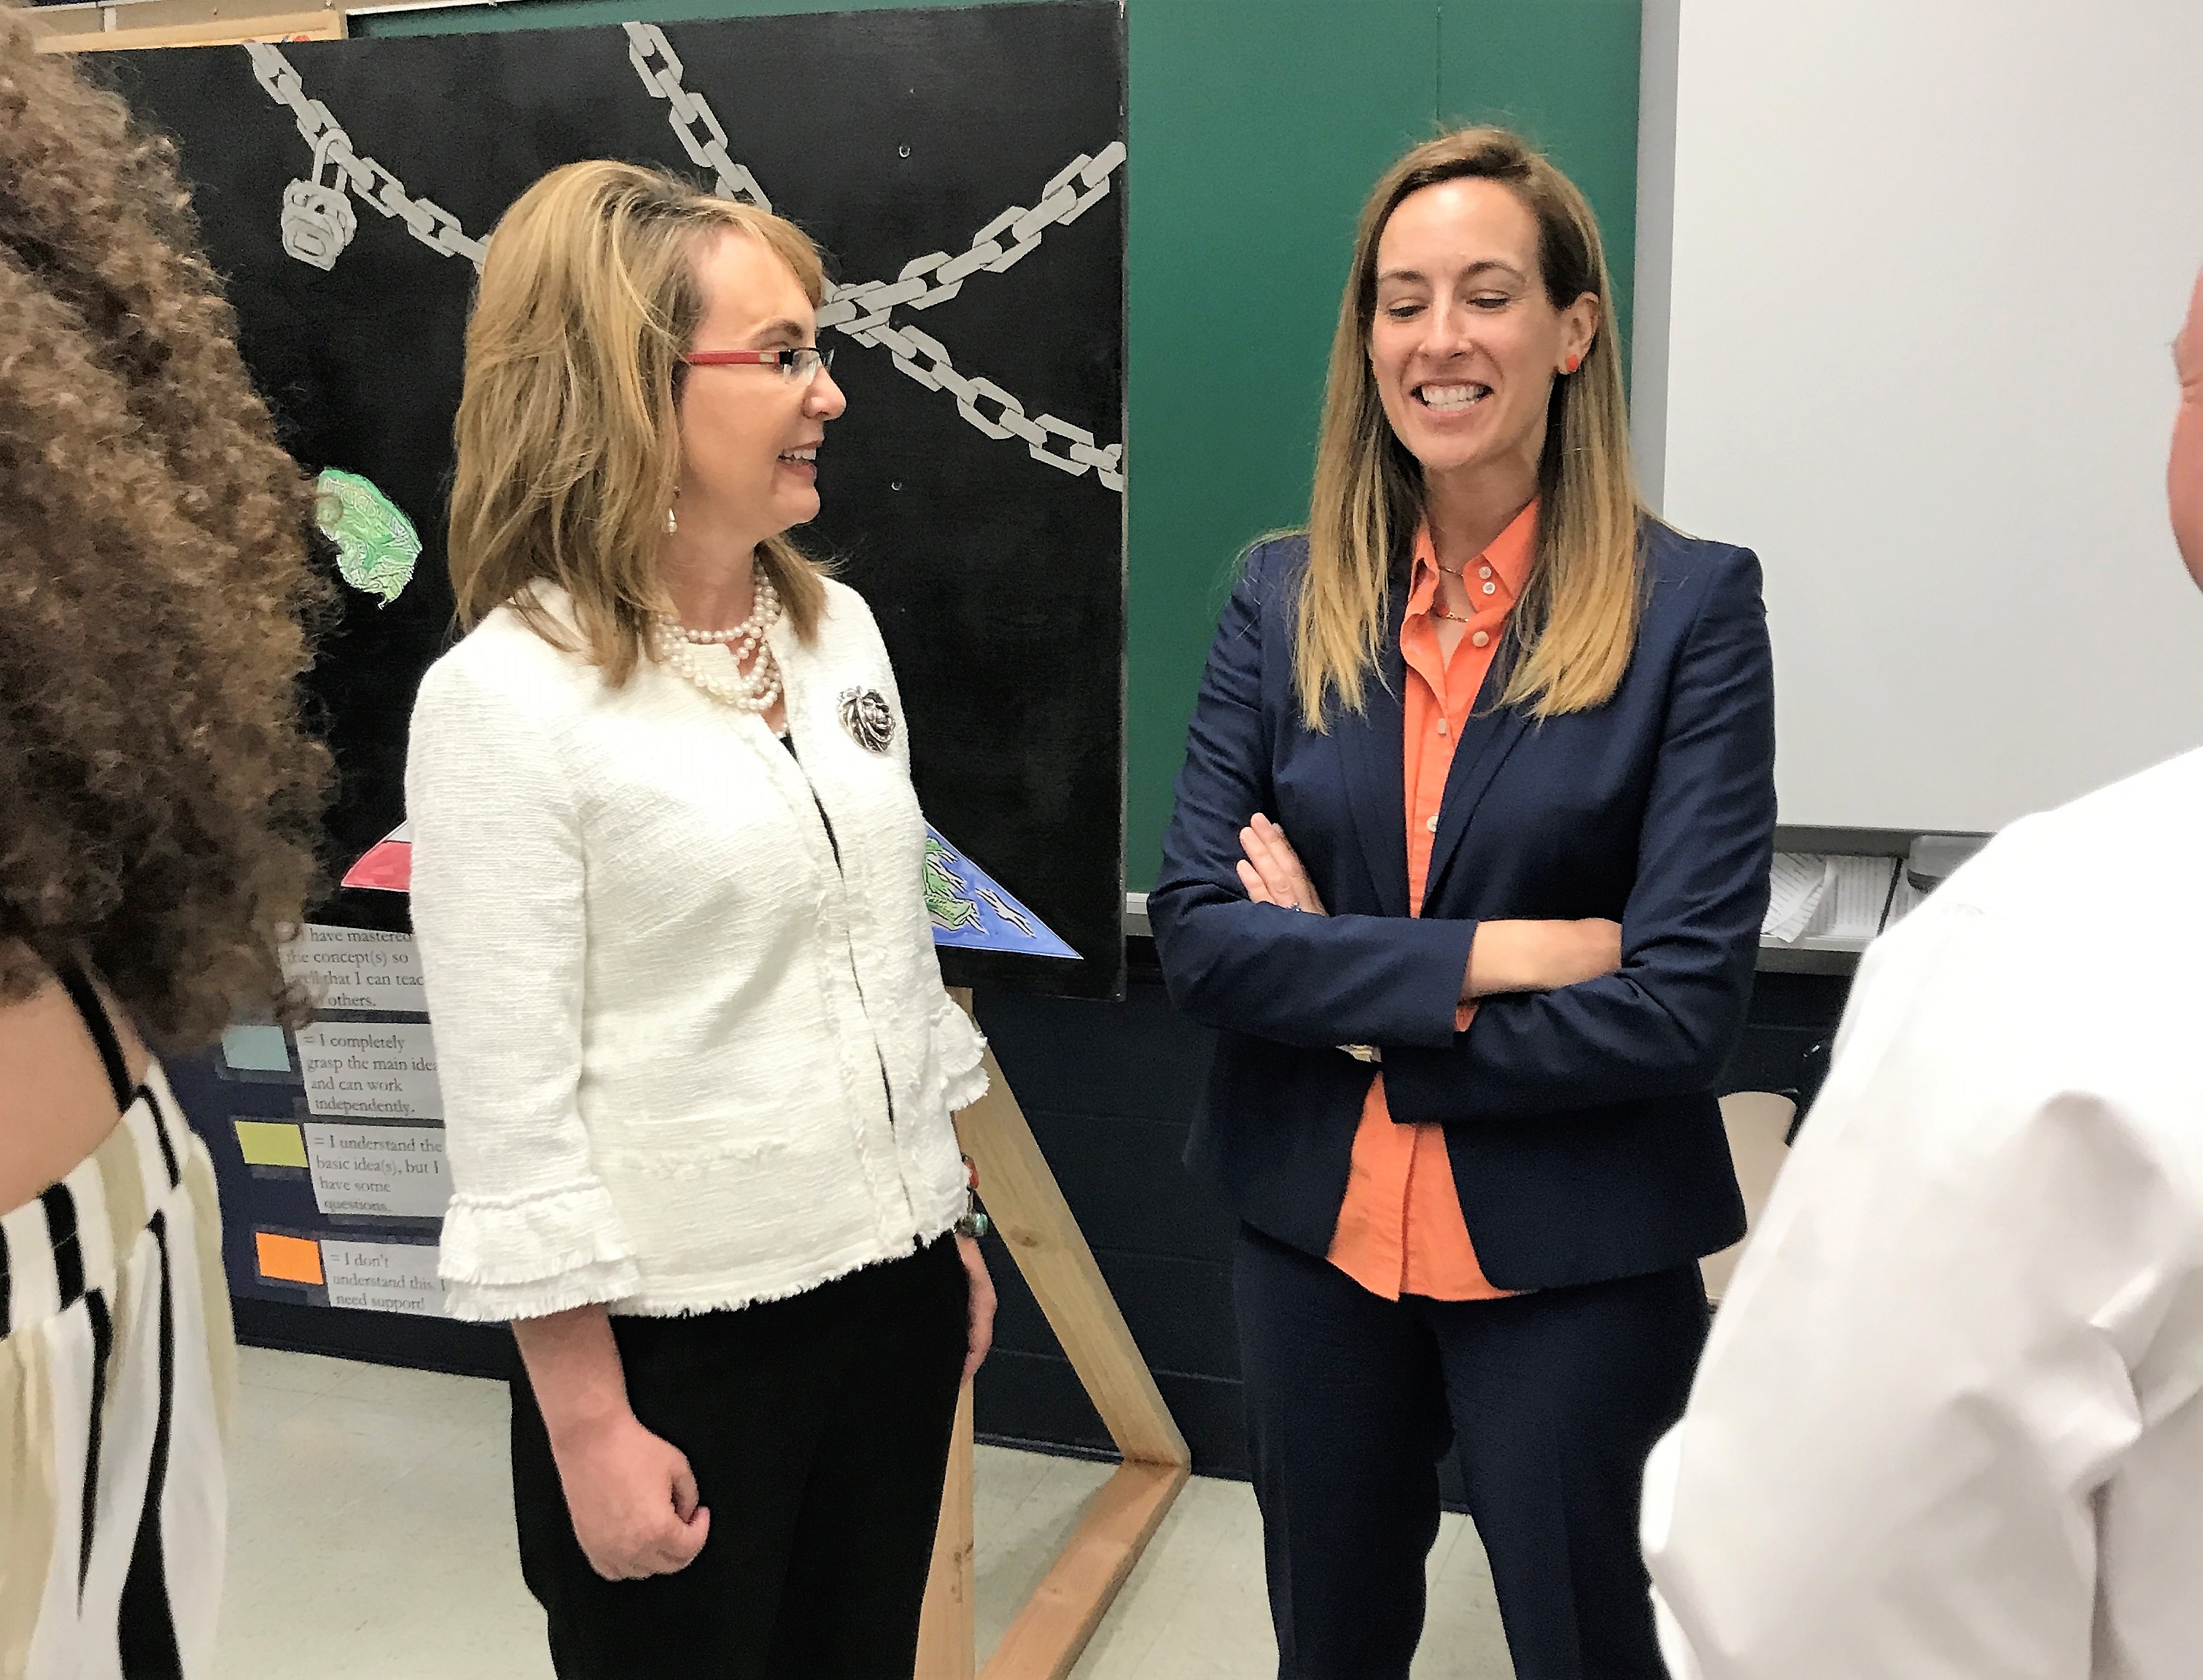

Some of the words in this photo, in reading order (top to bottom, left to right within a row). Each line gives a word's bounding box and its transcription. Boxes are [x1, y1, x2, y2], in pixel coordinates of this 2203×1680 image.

[310, 928, 343, 942] have
[314, 950, 387, 968] concept(s)
[392, 954, 408, 963] so
[323, 971, 350, 984] that
[354, 971, 361, 984] I
[366, 975, 391, 985] can
[396, 975, 424, 985] teac
[328, 993, 376, 1006] others.
[320, 1033, 325, 1046] I
[330, 1034, 405, 1053] completely
[307, 1057, 343, 1073] grasp
[347, 1055, 368, 1070] the
[373, 1057, 408, 1070] main
[311, 1076, 334, 1089] and
[338, 1082, 363, 1090] can
[367, 1078, 403, 1092] work
[315, 1096, 415, 1116] independently.
[330, 1135, 335, 1148] I
[340, 1135, 416, 1152] understand
[420, 1138, 443, 1152] the
[316, 1155, 350, 1170] basic
[354, 1157, 402, 1175] idea(s),
[405, 1159, 429, 1173] but
[433, 1160, 439, 1173] I
[319, 1176, 350, 1191] have
[354, 1182, 391, 1192] some
[325, 1199, 391, 1212] questions.
[345, 1253, 349, 1265] I
[354, 1253, 389, 1268] don't
[333, 1273, 405, 1288] understand
[440, 1278, 446, 1291] I
[336, 1293, 367, 1305] need
